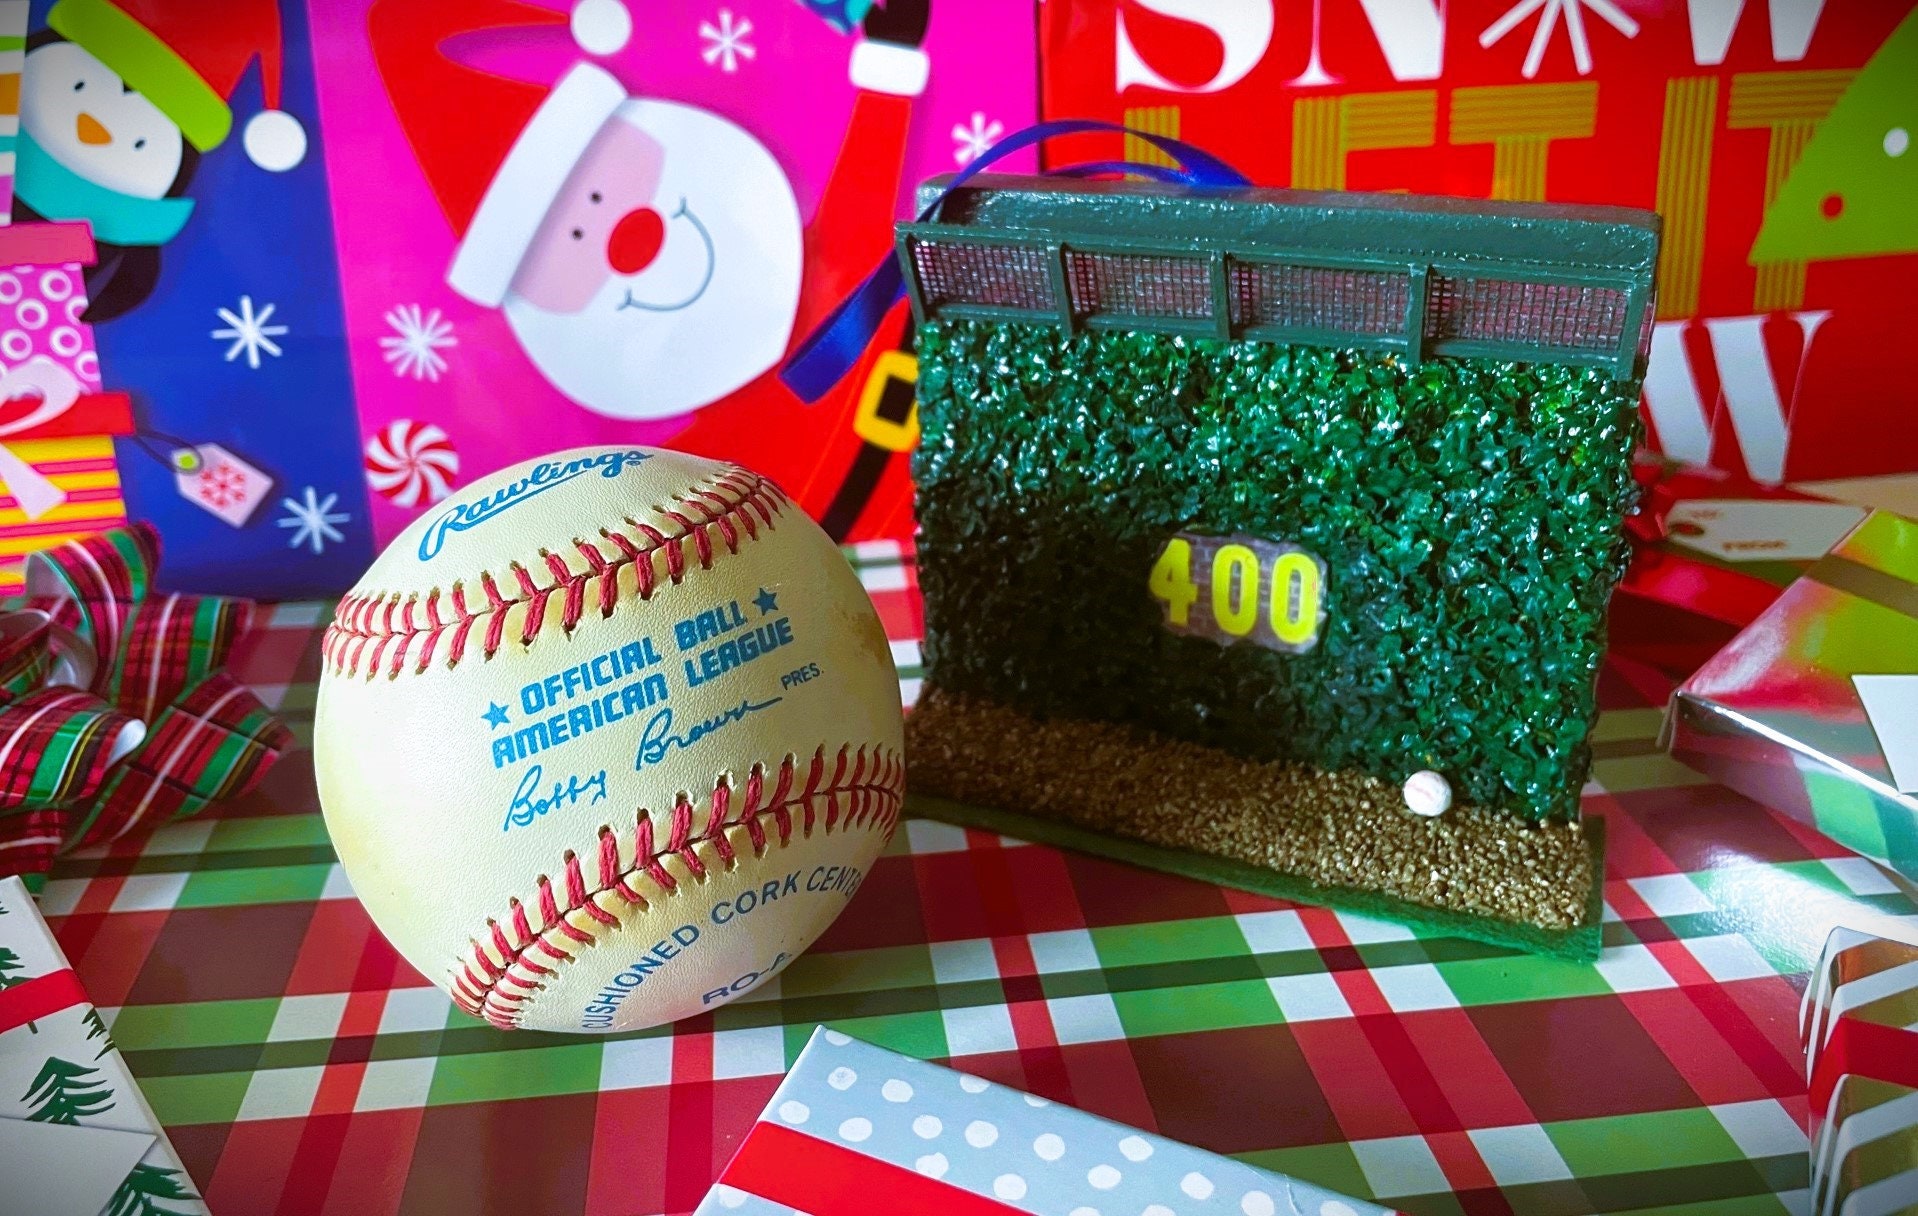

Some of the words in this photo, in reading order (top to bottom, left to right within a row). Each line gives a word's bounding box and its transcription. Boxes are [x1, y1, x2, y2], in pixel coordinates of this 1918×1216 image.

[418, 450, 654, 561] Rawlings
[520, 636, 662, 715] OFFICIAL
[674, 600, 748, 651] BALL
[1149, 538, 1319, 644] 400
[491, 672, 669, 769] AMERICAN
[684, 616, 794, 688] LEAGUE
[503, 764, 606, 831] Bobby
[635, 697, 783, 771] Brown
[780, 661, 824, 690] PRES.
[581, 924, 700, 1029] CUSHIONED
[711, 869, 801, 925] CORK
